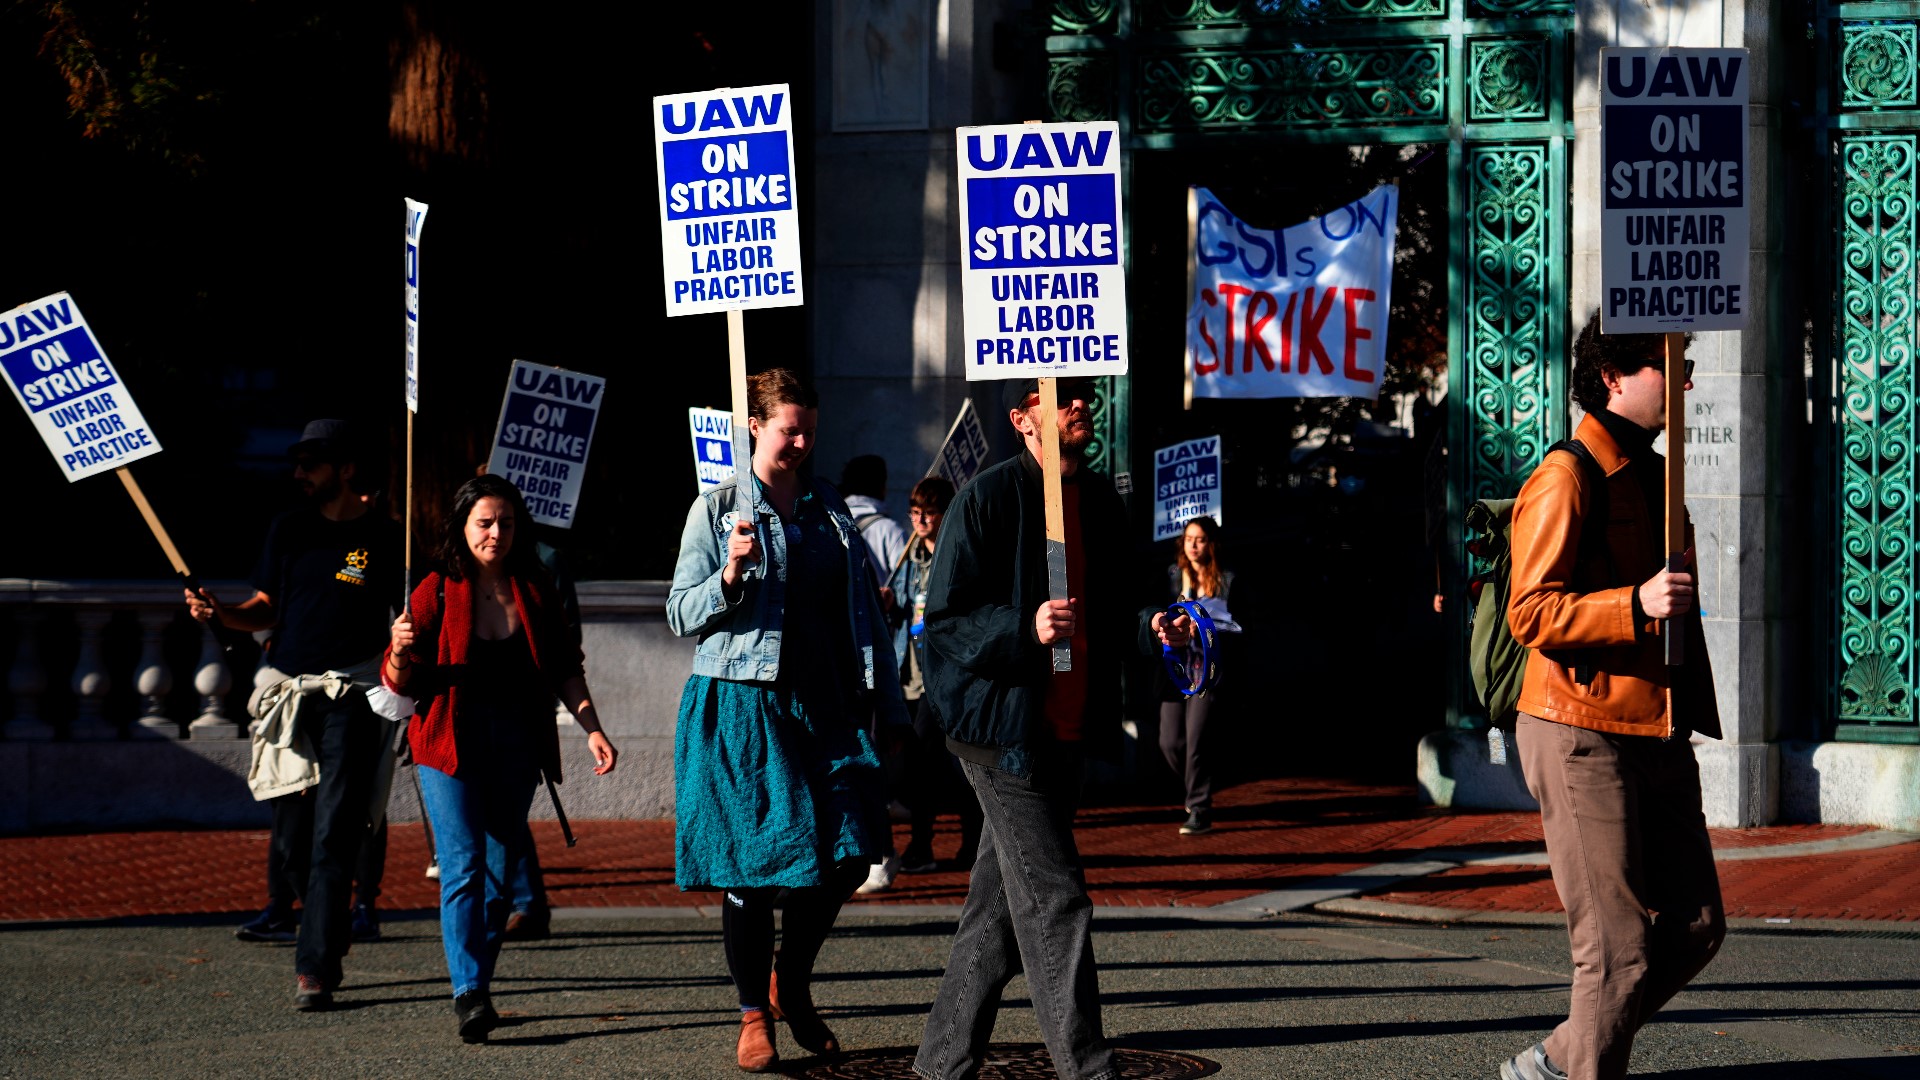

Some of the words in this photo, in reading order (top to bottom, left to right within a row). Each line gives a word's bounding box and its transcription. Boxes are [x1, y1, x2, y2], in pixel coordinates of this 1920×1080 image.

[1607, 57, 1742, 98] UAW
[661, 92, 784, 135] UAW
[967, 130, 1113, 171] UAW
[1650, 114, 1700, 154] ON
[701, 140, 749, 174] ON
[669, 174, 787, 213] STRIKE
[1610, 159, 1738, 200] STRIKE
[1013, 182, 1069, 219] ON
[685, 217, 776, 247] UNFAIR
[1320, 194, 1389, 241] ON
[1626, 214, 1725, 246] UNFAIR
[973, 222, 1113, 261] STRIKE
[691, 245, 773, 274] LABOR
[1631, 250, 1720, 281] LABOR
[674, 271, 796, 304] PRACTICE
[991, 272, 1099, 301] UNFAIR
[1610, 285, 1740, 318] PRACTICE
[0, 299, 73, 351] UAW
[999, 304, 1095, 333] LABOR
[1195, 283, 1376, 383] STRIKE
[31, 340, 71, 372] ON
[976, 335, 1120, 365] PRACTICE
[22, 358, 112, 407] STRIKE
[515, 366, 601, 404] UAW
[49, 392, 118, 428] UNFAIR
[533, 403, 568, 428] ON
[693, 414, 728, 436] UAW
[1696, 403, 1715, 415] BY
[64, 413, 126, 447] LABOR
[503, 422, 586, 457] STRIKE
[965, 406, 985, 458] UAW
[1683, 426, 1736, 443] THER
[63, 428, 152, 472] PRACTICE
[506, 452, 570, 480] UNFAIR
[705, 440, 723, 461] ON
[1158, 439, 1217, 465] UAW
[1159, 472, 1216, 498] STRIKE
[1174, 461, 1198, 479] ON
[524, 496, 572, 520] CTICE
[1165, 492, 1210, 511] UNFAIR
[1167, 504, 1207, 521] LABOR
